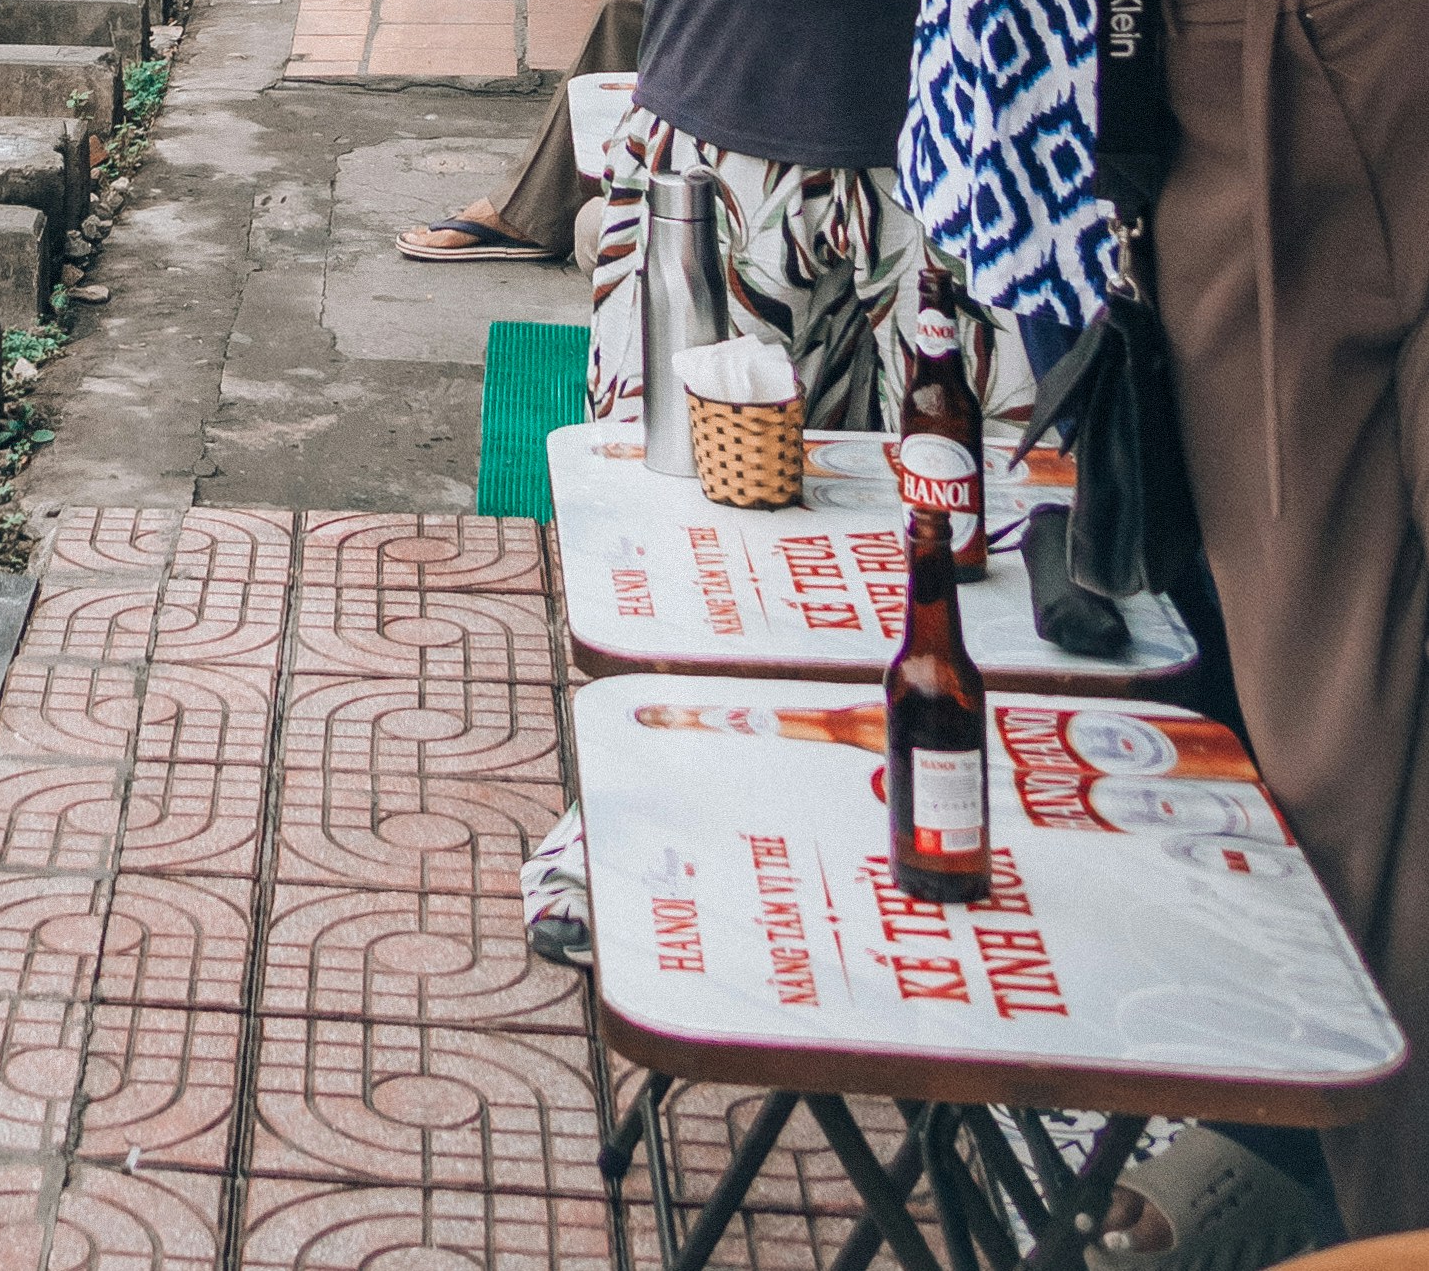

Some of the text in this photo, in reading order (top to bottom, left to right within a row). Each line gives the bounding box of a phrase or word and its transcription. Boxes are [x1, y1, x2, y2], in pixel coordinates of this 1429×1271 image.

[919, 322, 957, 340] ANOI
[903, 473, 970, 507] HANOI
[844, 530, 908, 574] HOA
[611, 569, 655, 618] HANOI
[652, 897, 706, 974] HANOI
[973, 925, 1070, 1021] TINH
